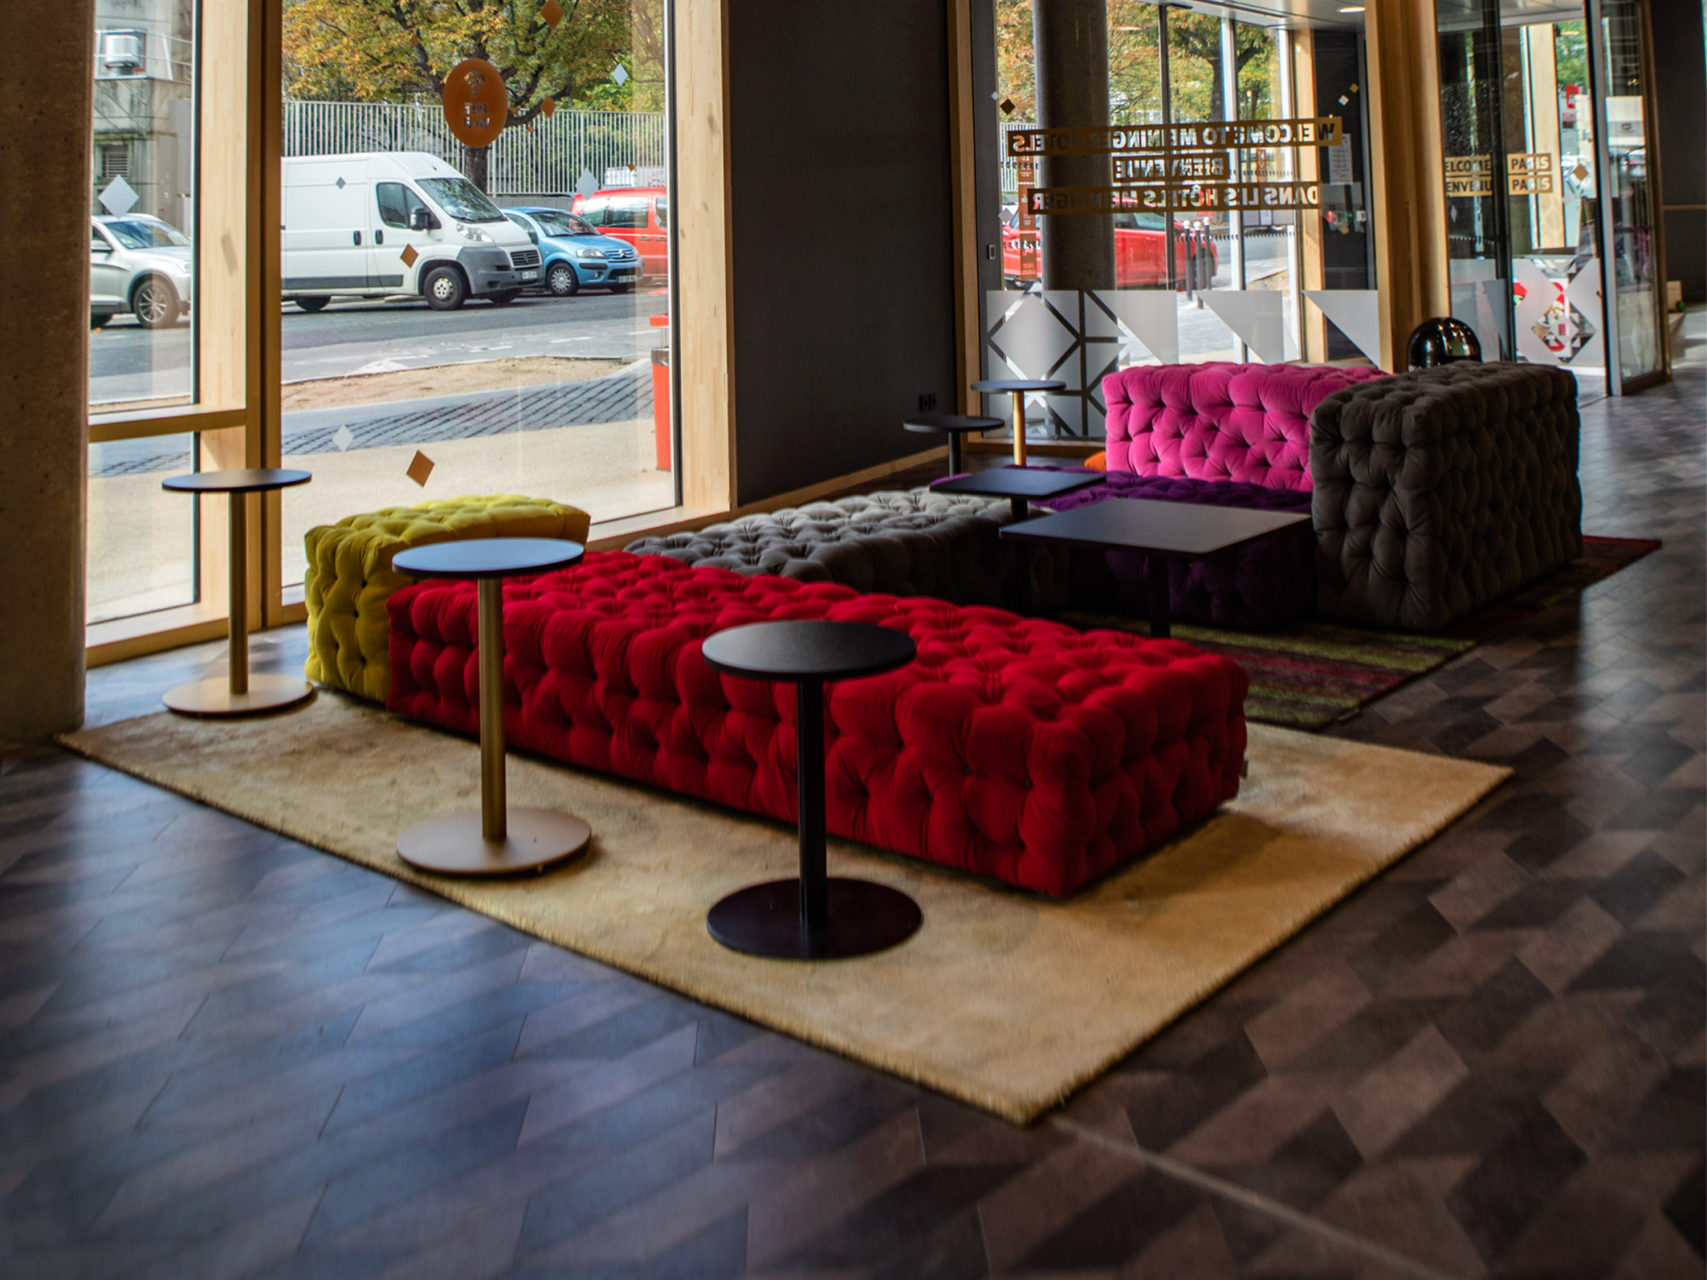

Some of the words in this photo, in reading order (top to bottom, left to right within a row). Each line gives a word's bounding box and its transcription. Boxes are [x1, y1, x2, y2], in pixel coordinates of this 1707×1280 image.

[1445, 159, 1491, 173] ELCOME
[1511, 155, 1549, 171] PARIS
[1446, 179, 1492, 193] ENVENU
[1512, 176, 1550, 192] PARIS
